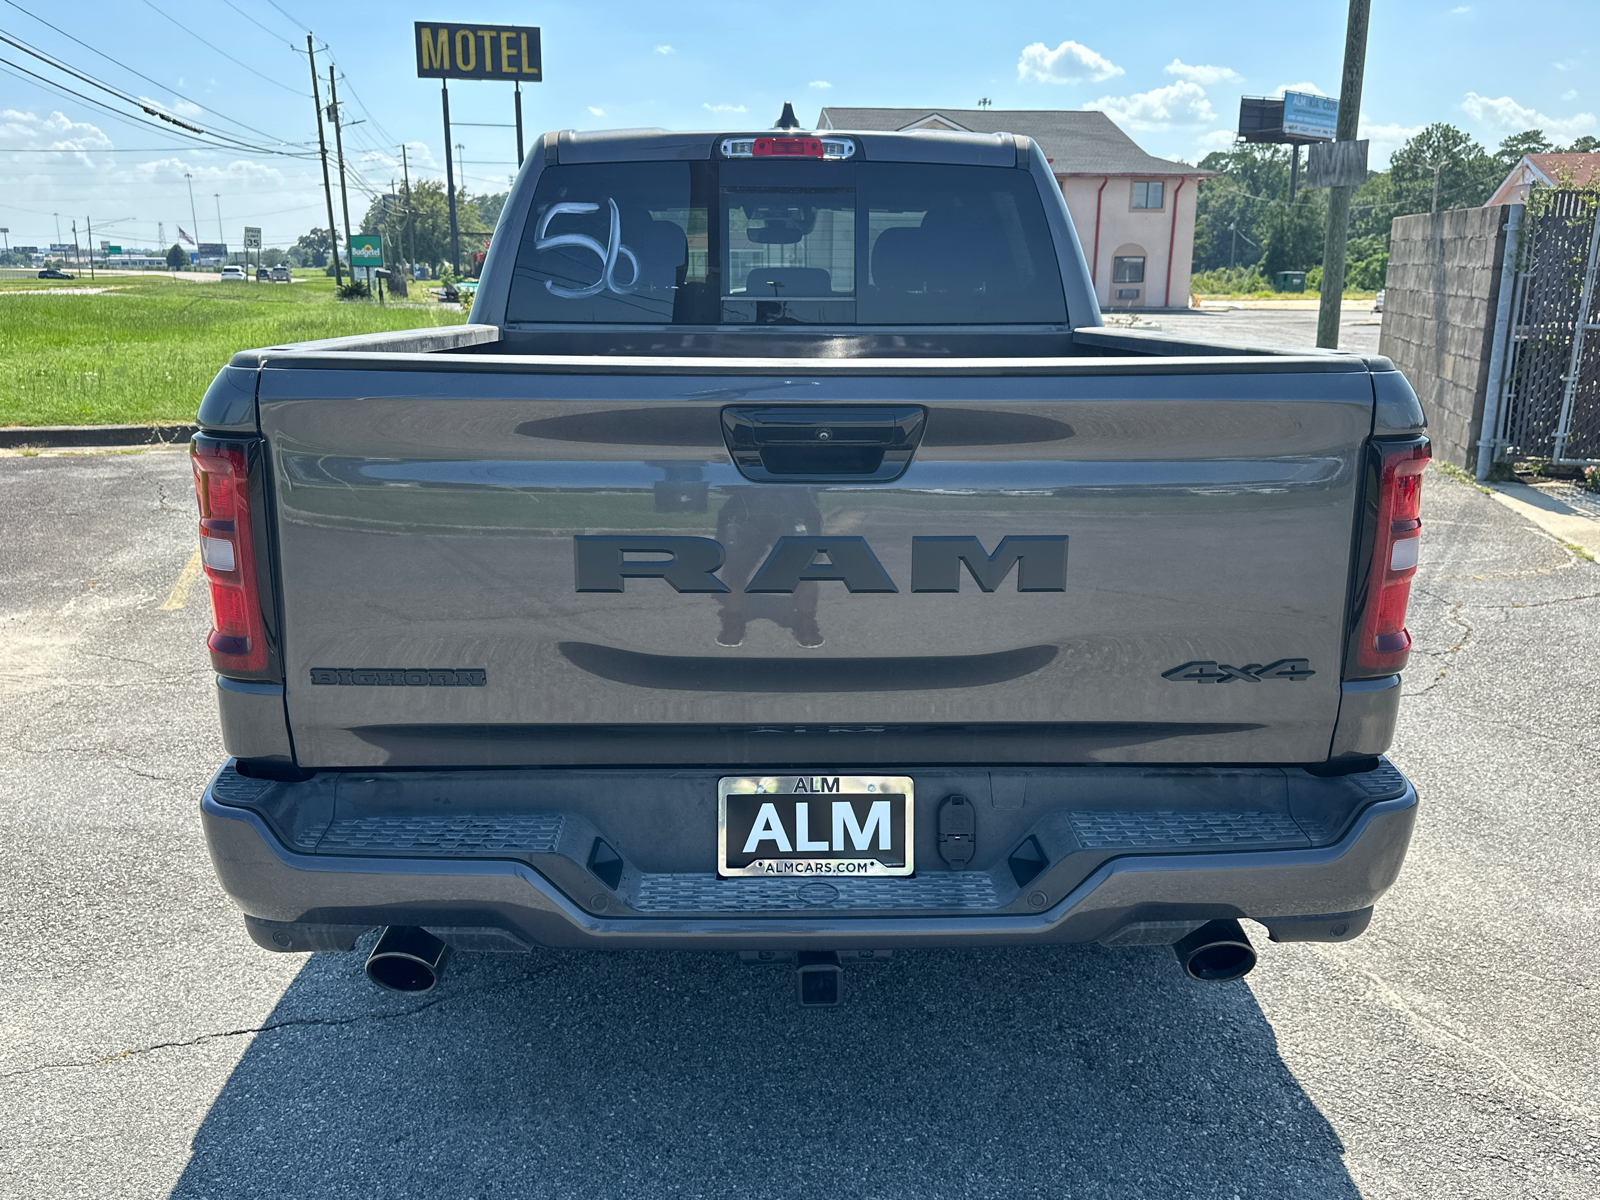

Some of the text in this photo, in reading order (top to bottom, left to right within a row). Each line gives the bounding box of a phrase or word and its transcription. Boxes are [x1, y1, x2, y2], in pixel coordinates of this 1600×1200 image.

[421, 28, 538, 73] MOTEL
[1293, 95, 1306, 107] ALM
[1309, 98, 1319, 108] KIA
[352, 247, 380, 258] Budgetel
[574, 535, 1069, 593] RAM
[310, 667, 487, 686] BIGHORN
[793, 777, 840, 793] ALM
[742, 801, 891, 853] ALM
[765, 862, 868, 873] ALMCARS.COM
